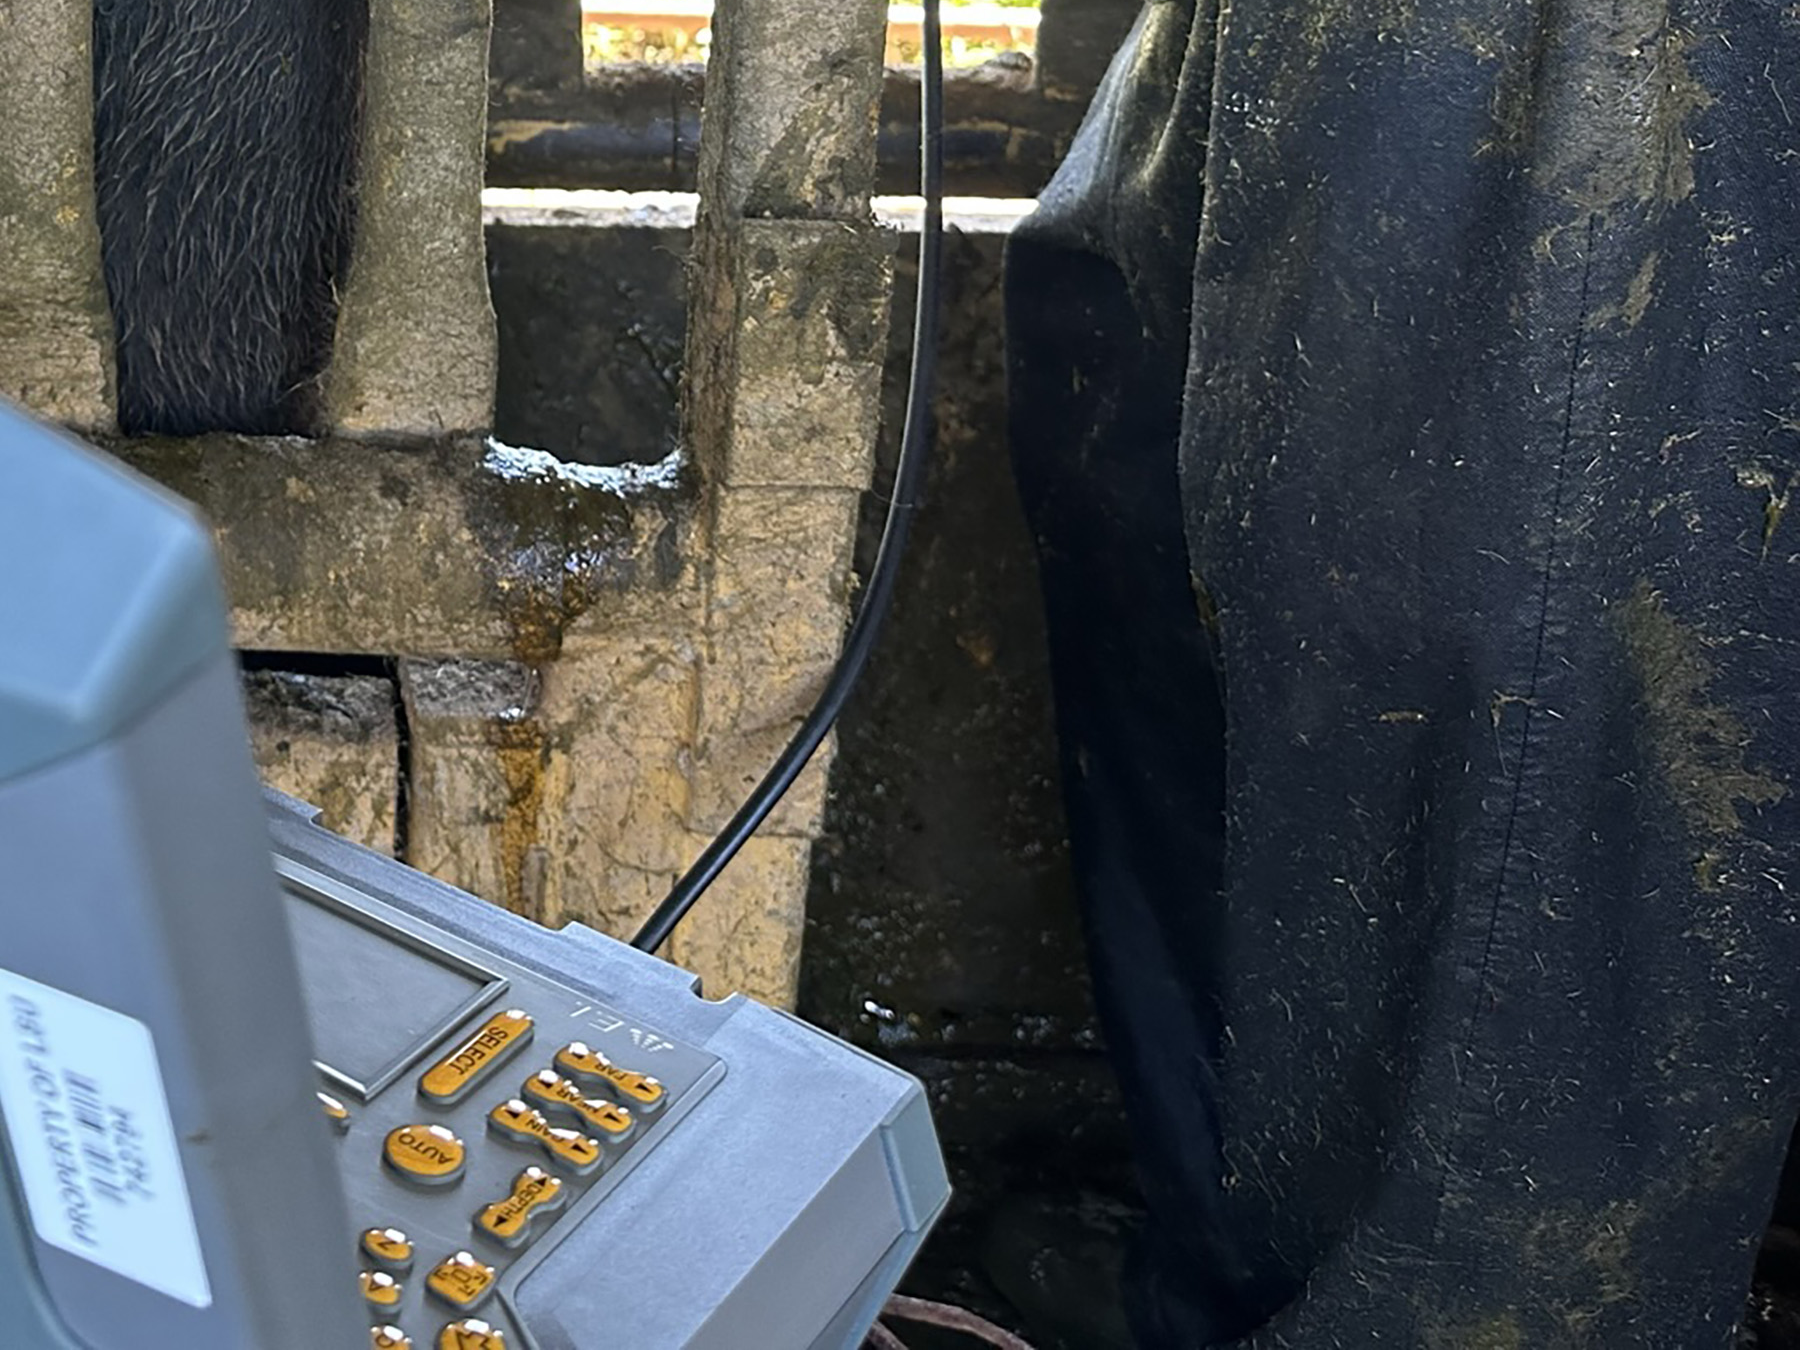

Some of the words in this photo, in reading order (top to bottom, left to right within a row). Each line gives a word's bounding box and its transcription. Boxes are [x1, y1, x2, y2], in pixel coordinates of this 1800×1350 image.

[448, 1026, 509, 1075] SELECT
[25, 1058, 59, 1099] OF
[595, 1061, 630, 1081] FAR
[398, 1133, 454, 1165] AUTO
[38, 1101, 97, 1247] PROPERTY
[503, 1182, 543, 1219] DEPTH
